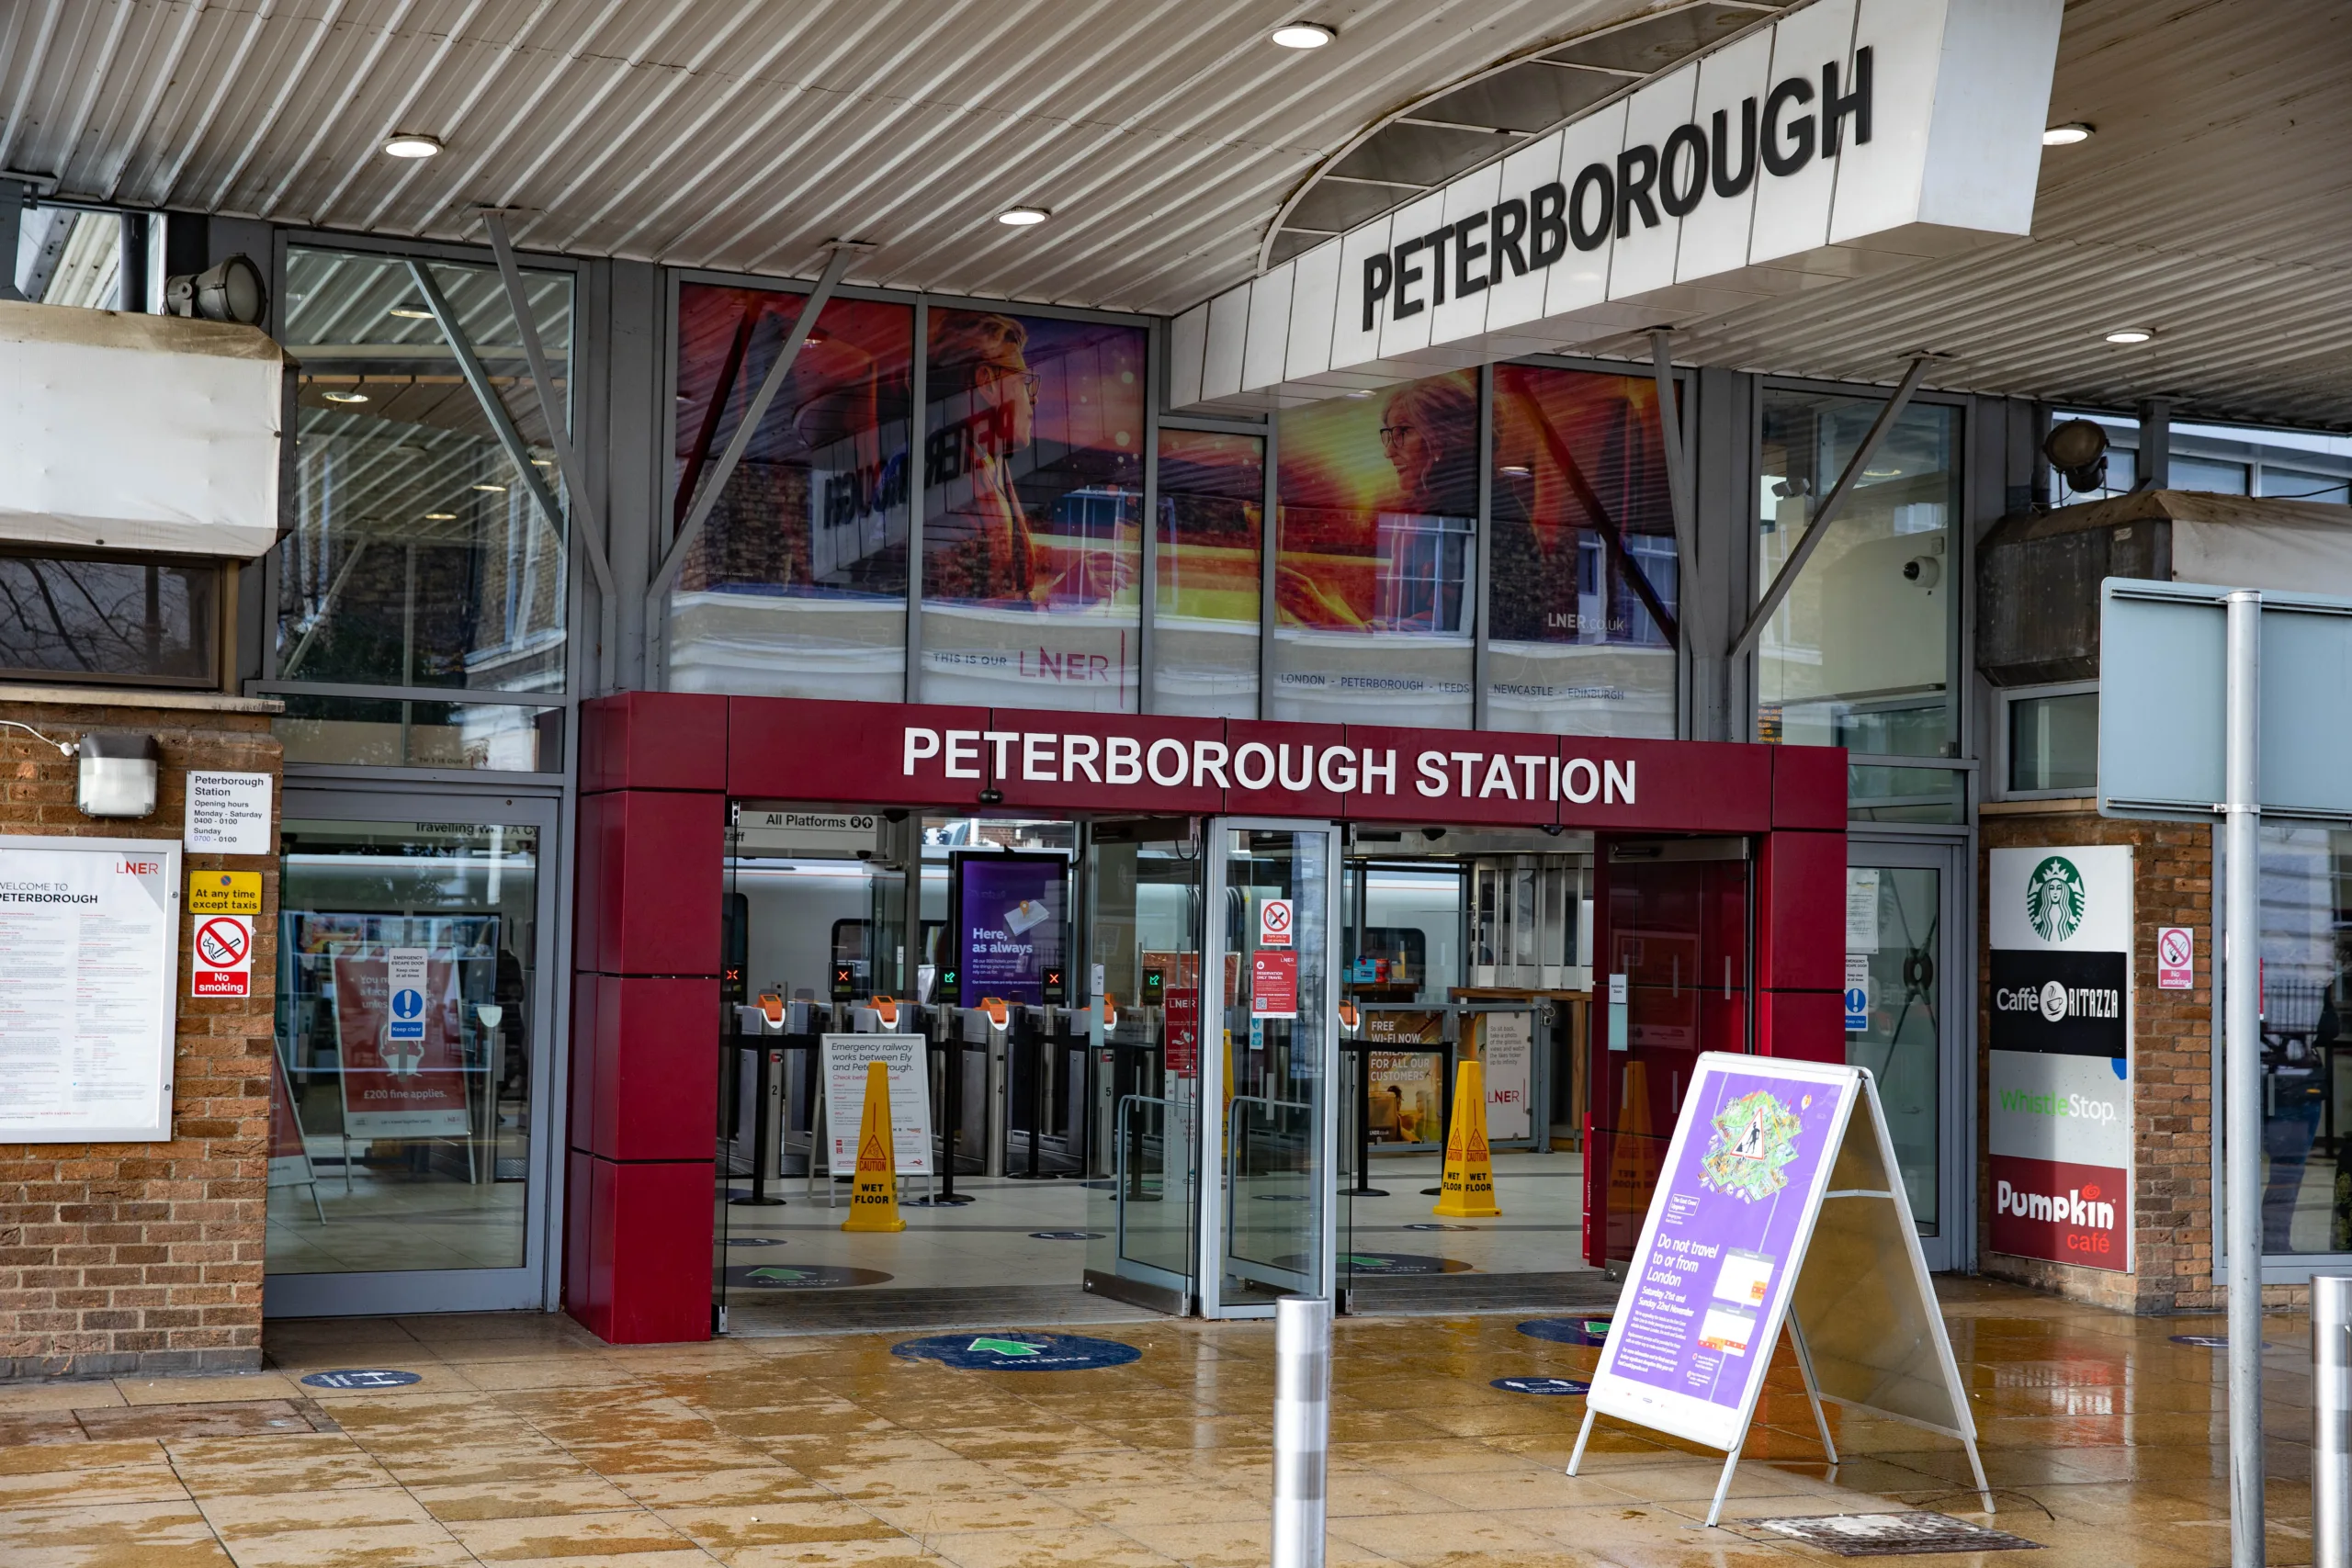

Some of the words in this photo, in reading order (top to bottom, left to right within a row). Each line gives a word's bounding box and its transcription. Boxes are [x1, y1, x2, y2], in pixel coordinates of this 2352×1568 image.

[1363, 45, 1872, 332] PETERBOROUGH
[1548, 612, 1624, 631] LNER.co.uk
[933, 653, 960, 663] THIS
[966, 656, 977, 664] IS
[981, 656, 1007, 666] OUR
[1020, 646, 1109, 682] LNER
[1281, 673, 1325, 685] LONDON
[1340, 677, 1423, 691] PETERBOROUGH
[1439, 682, 1470, 694] LEEDS
[1494, 684, 1554, 696] NEWCASTLE
[1567, 688, 1624, 700] EDINBURGH
[902, 727, 1396, 795] PETERBOROUGH
[1415, 750, 1635, 805] STATION
[195, 775, 264, 786] Peterborough
[195, 787, 231, 796] Station
[194, 800, 226, 808] Opening
[194, 810, 223, 818] Monday
[230, 811, 263, 819] Saturday
[766, 814, 782, 825] All
[786, 815, 846, 828] Platforms
[194, 828, 221, 836] Sunday
[724, 831, 745, 842] taff
[116, 861, 159, 875] LNER
[54, 883, 68, 891] TO
[195, 889, 209, 897] At
[211, 891, 230, 900] any
[233, 889, 255, 898] time
[192, 901, 228, 910] except
[232, 900, 257, 909] taxis
[972, 928, 1008, 941] Here,
[972, 944, 987, 953] as
[989, 942, 1033, 956] always
[214, 973, 230, 982] No
[198, 983, 244, 994] smoking
[1169, 999, 1196, 1010] LNER
[1996, 986, 2039, 1011] Caffè
[2068, 987, 2119, 1019] RITAZZA
[1371, 1021, 1395, 1031] FREE
[1371, 1033, 1396, 1043] WI-FI
[1398, 1033, 1421, 1043] NOW
[831, 1043, 880, 1052] Emergency
[882, 1043, 913, 1053] railway
[899, 1053, 912, 1062] Ely
[1371, 1058, 1389, 1068] FOR
[1392, 1058, 1408, 1068] ALL
[1410, 1058, 1430, 1068] OUR
[1370, 1071, 1425, 1081] CUSTOMERS
[363, 1089, 388, 1100] £200
[390, 1089, 408, 1099] fine
[410, 1088, 447, 1100] applies.
[772, 1085, 778, 1096] 2
[997, 1085, 1003, 1096] 4
[1105, 1087, 1112, 1097] 5
[1487, 1088, 1520, 1105] LNER
[1466, 1152, 1488, 1162] CAUTION
[859, 1160, 887, 1171] CAUTION
[1447, 1171, 1460, 1180] WET
[1469, 1172, 1487, 1181] WET
[861, 1183, 884, 1192] WET
[1442, 1181, 1463, 1192] FLOOR
[1465, 1183, 1492, 1192] FLOOR
[854, 1195, 889, 1204] FLOOR
[1997, 1179, 2115, 1230] Pumpkin
[1657, 1233, 1672, 1249] Do
[1672, 1240, 1690, 1253] not
[1690, 1241, 1720, 1258] travel
[2066, 1232, 2110, 1254] café
[1652, 1250, 1663, 1265] to
[1664, 1255, 1676, 1268] or
[1675, 1254, 1699, 1273] from
[1645, 1266, 1682, 1287] London
[1641, 1285, 1665, 1300] Saturday
[1664, 1290, 1676, 1301] 21st
[1675, 1294, 1687, 1303] and
[1637, 1296, 1657, 1311] Sunday
[1657, 1301, 1671, 1313] 22nd
[1669, 1304, 1695, 1317] November
[991, 1356, 1091, 1365] Entrance
